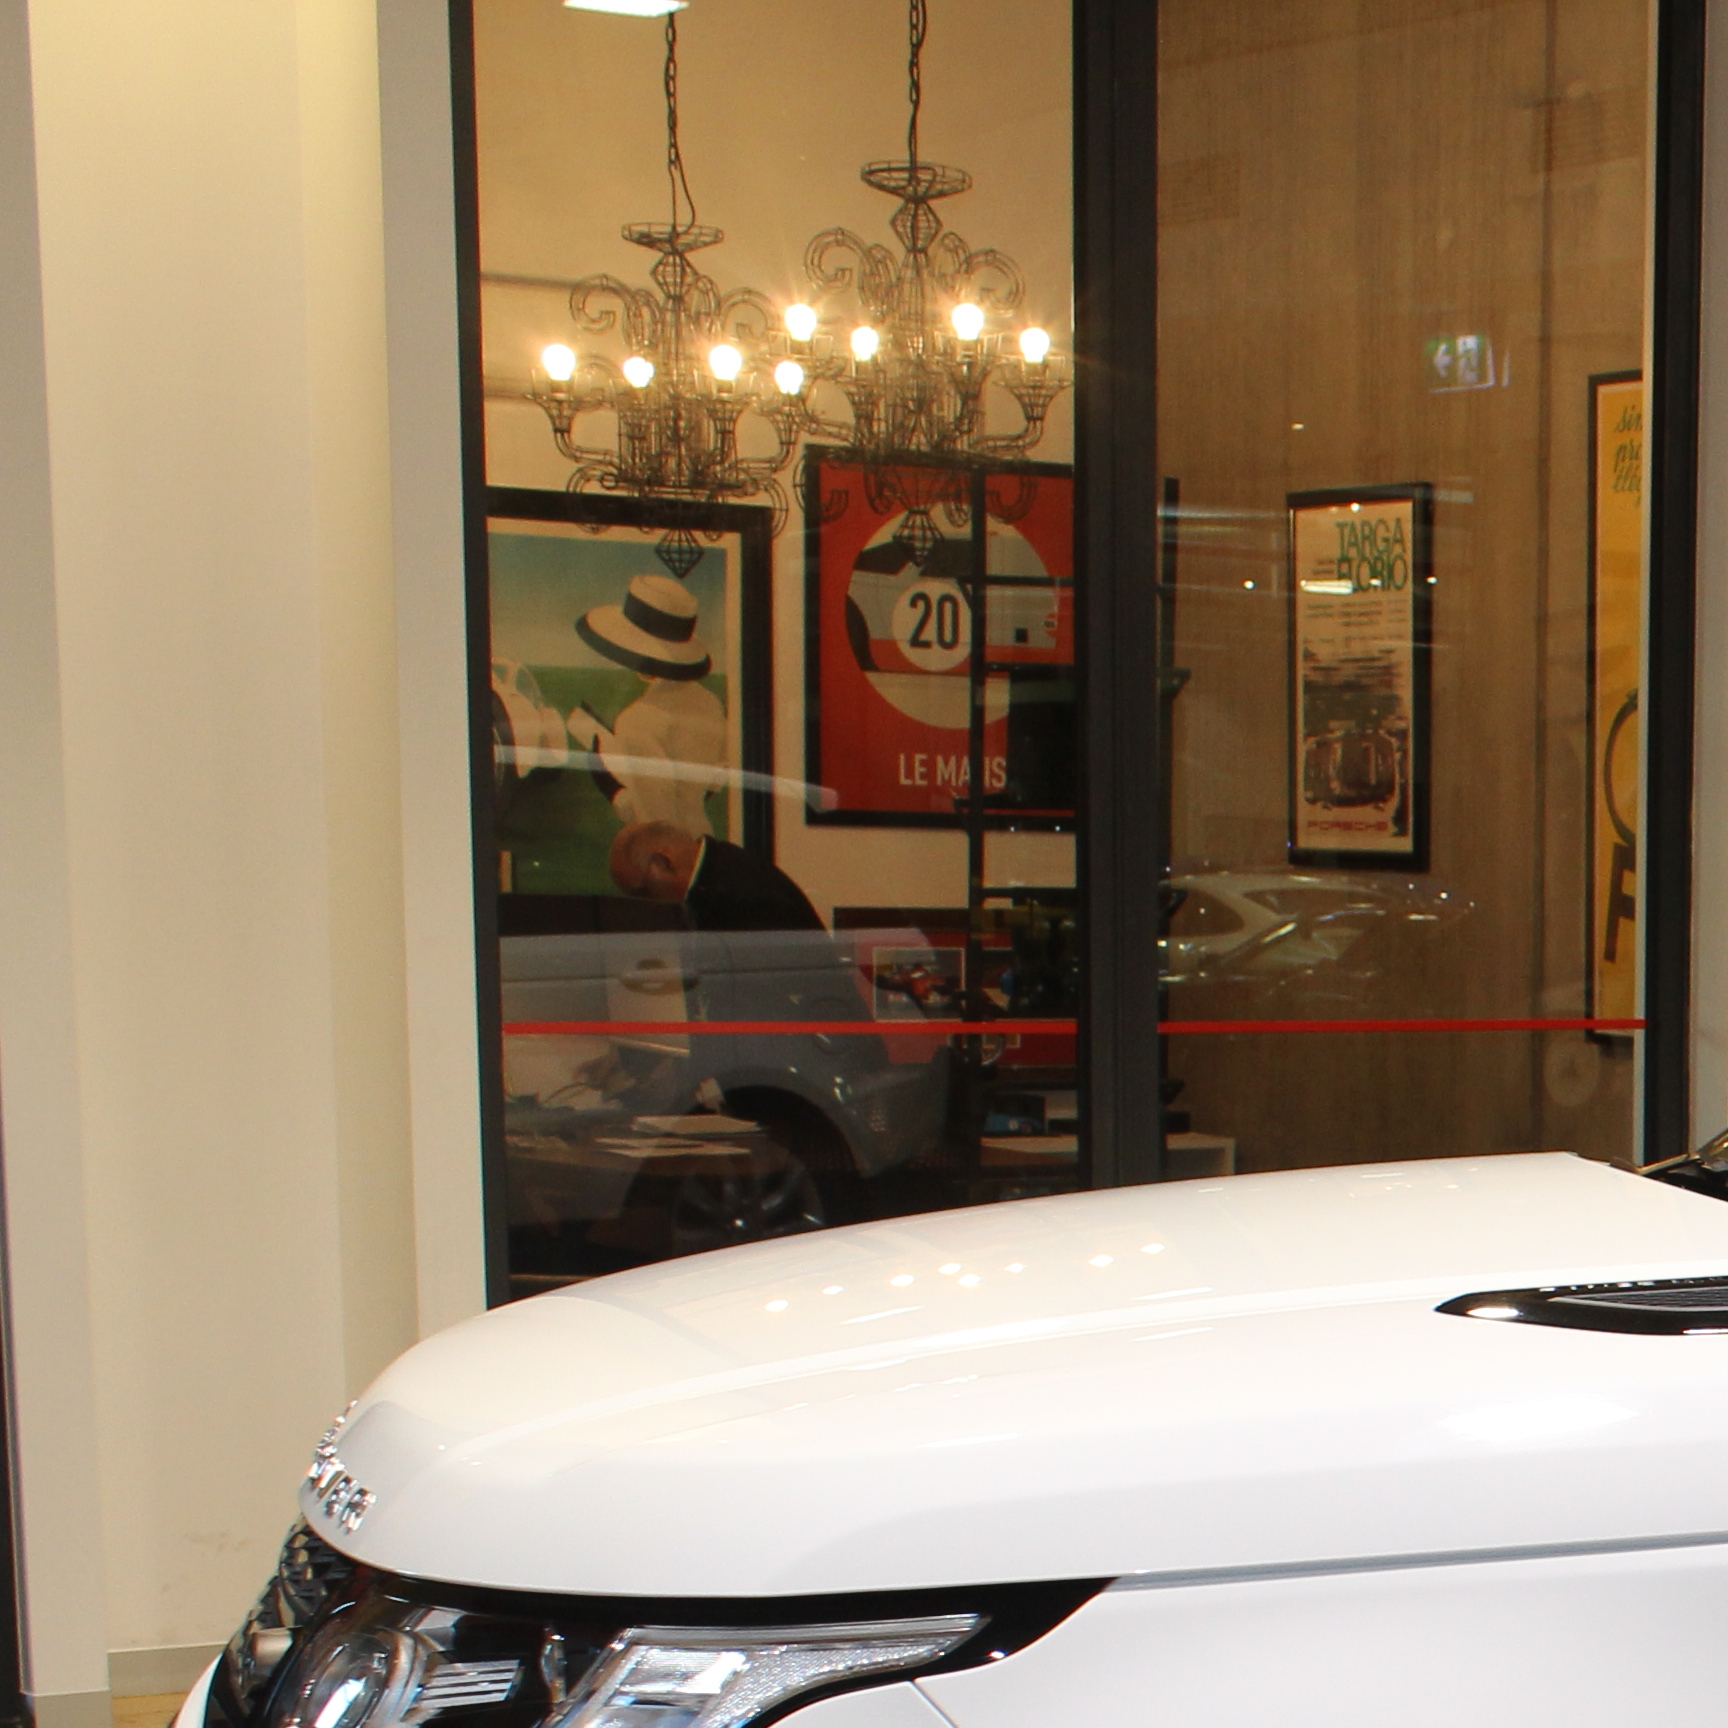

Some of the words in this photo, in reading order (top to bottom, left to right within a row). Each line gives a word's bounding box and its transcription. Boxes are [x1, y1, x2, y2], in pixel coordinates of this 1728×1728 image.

[1335, 517, 1406, 560] TARGA
[909, 591, 960, 650] 20
[898, 753, 928, 786] LE
